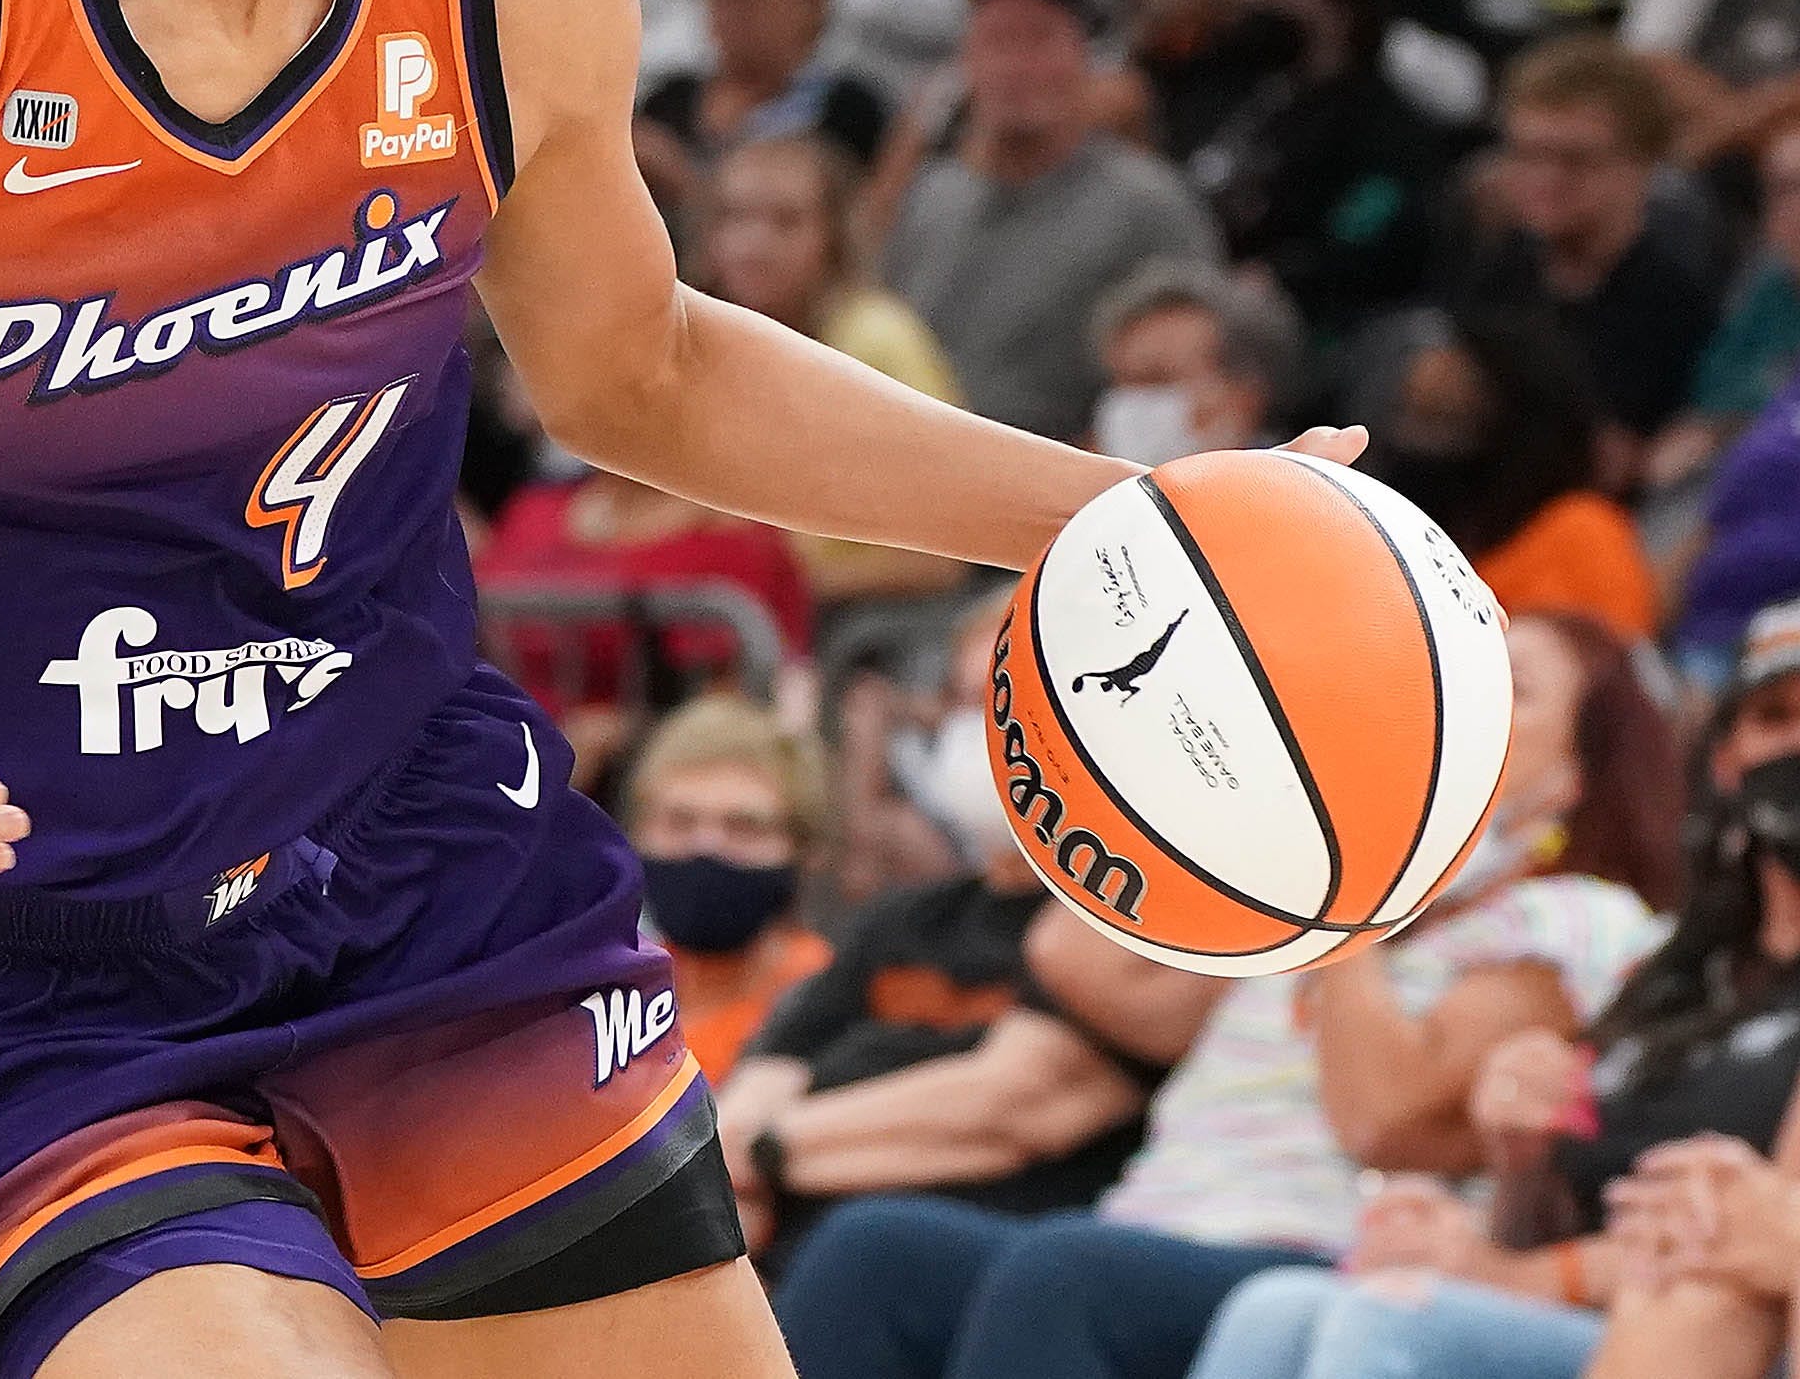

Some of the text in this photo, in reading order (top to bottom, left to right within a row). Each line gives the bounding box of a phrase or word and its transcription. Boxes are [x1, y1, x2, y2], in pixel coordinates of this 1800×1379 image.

[365, 119, 452, 159] PayPal
[246, 375, 417, 589] 4
[127, 639, 331, 680] FOOD STORES
[1174, 692, 1204, 739] BALL
